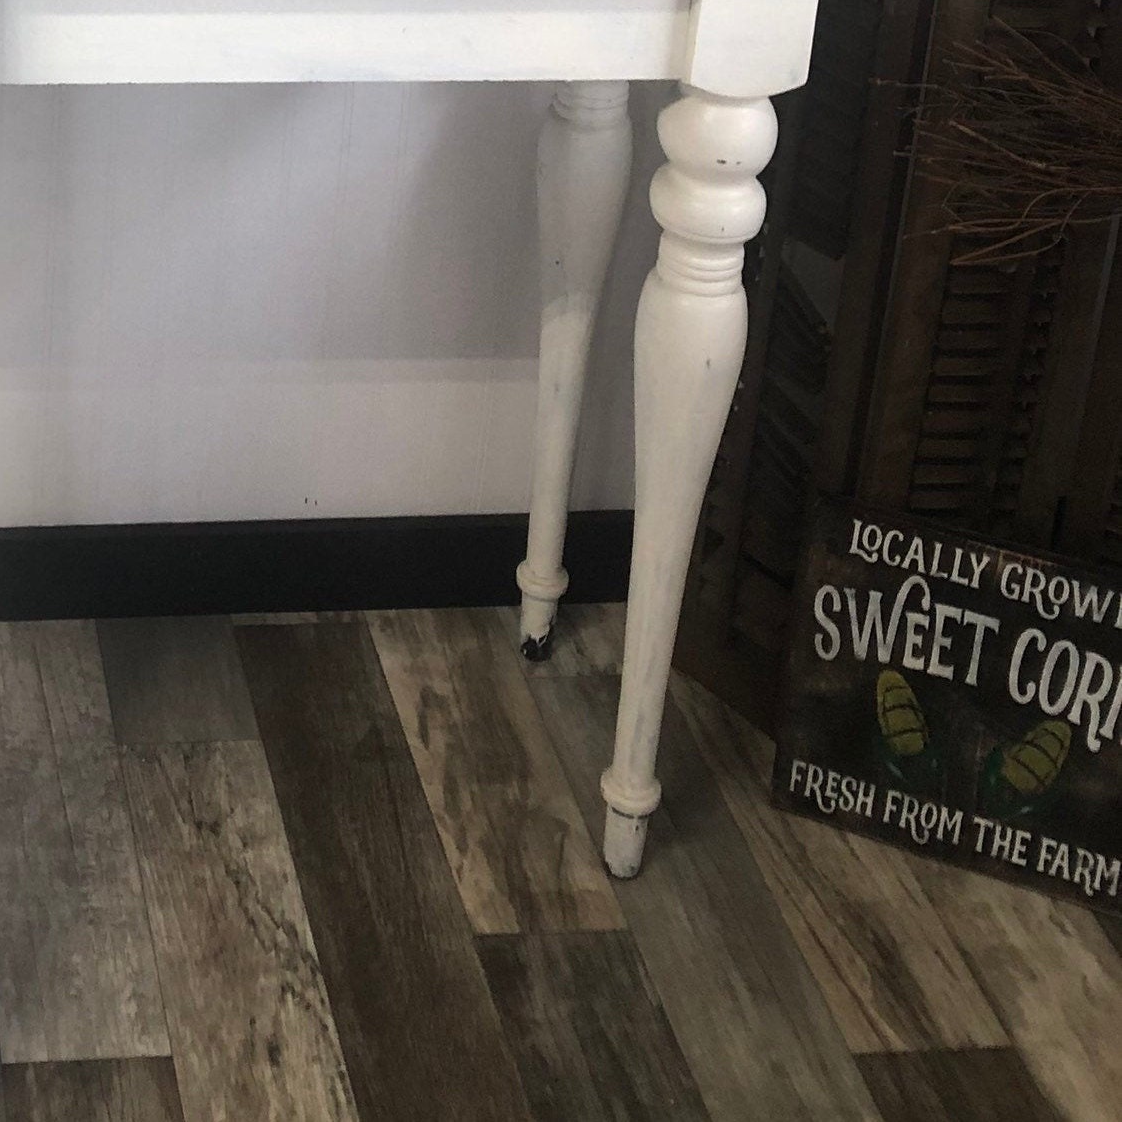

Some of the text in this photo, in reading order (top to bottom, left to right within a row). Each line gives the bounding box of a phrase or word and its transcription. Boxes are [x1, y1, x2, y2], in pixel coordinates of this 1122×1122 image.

[849, 519, 1122, 630] LOCALLY GROW
[814, 575, 1000, 686] SWEET
[789, 759, 1121, 897] FRESH FROM THE FARM
